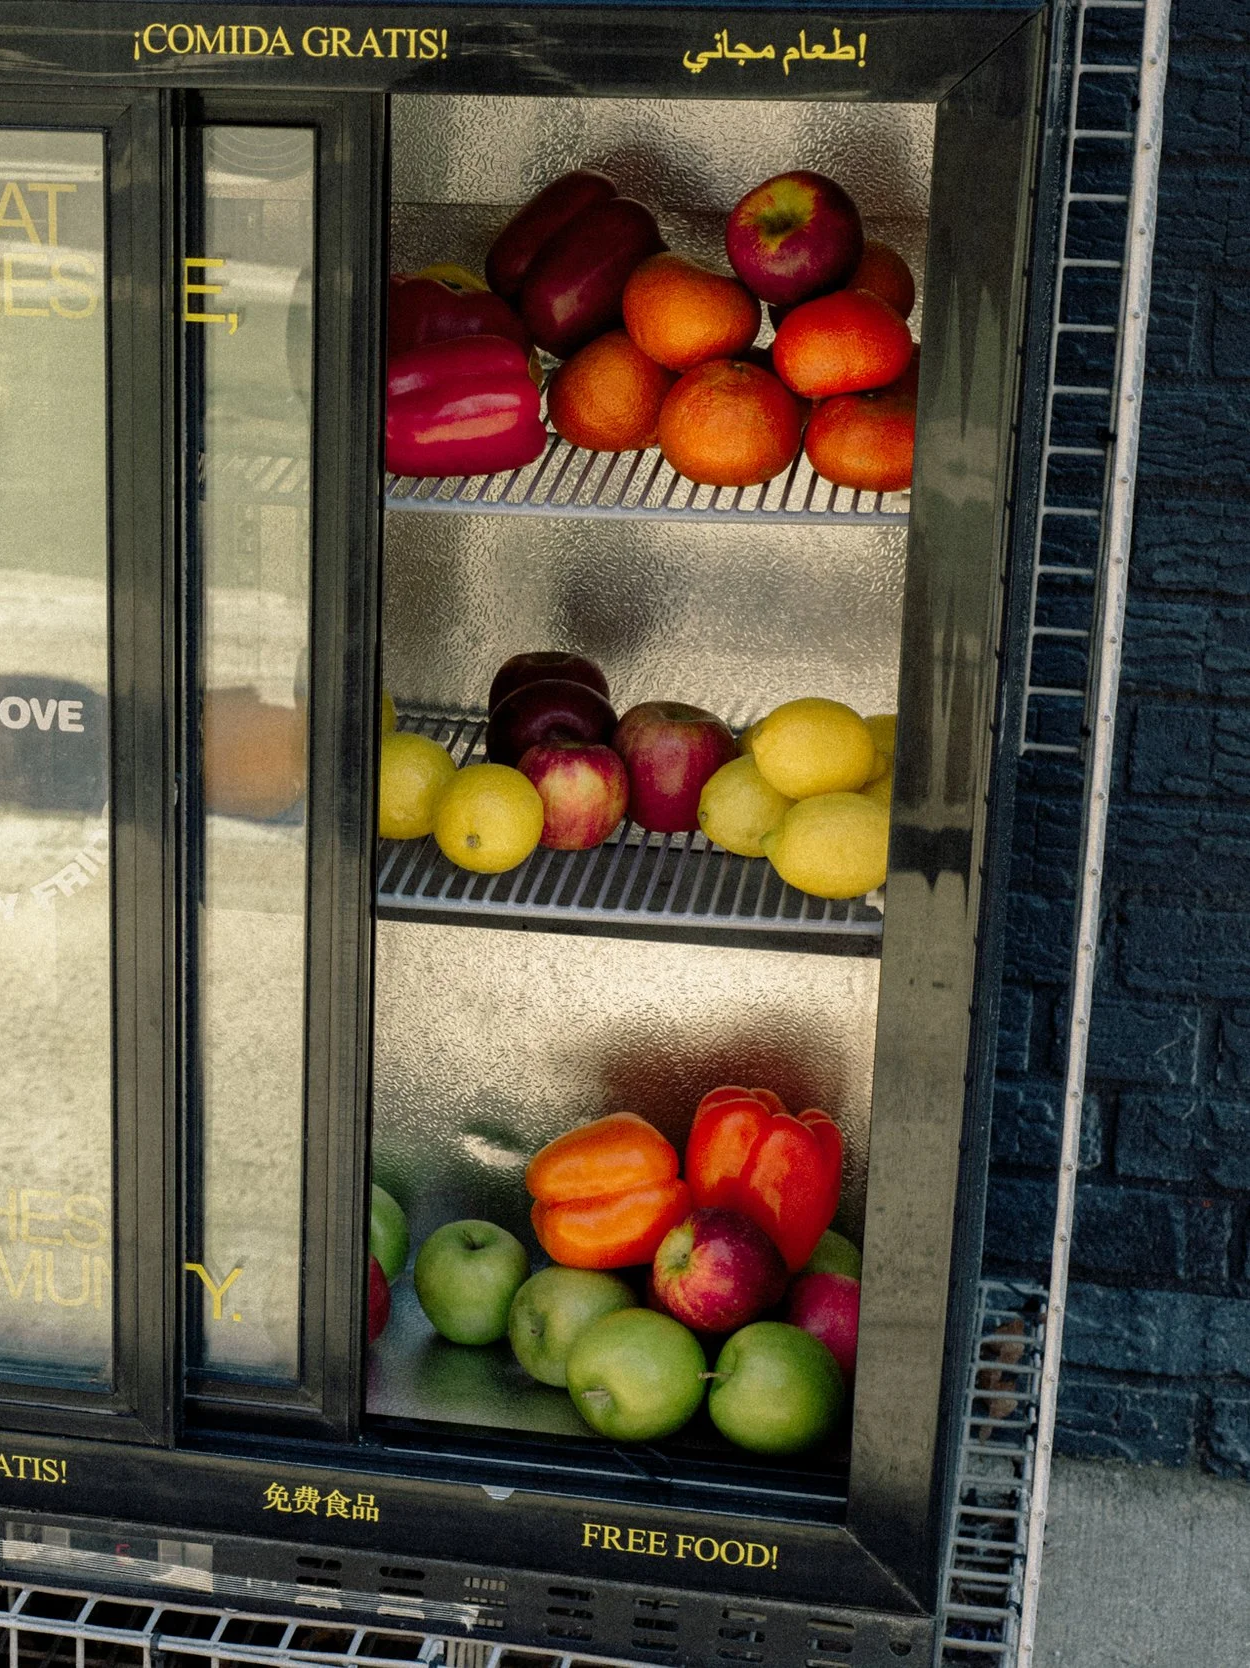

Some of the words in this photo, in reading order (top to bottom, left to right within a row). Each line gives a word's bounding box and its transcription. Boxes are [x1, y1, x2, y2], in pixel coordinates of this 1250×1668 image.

[133, 23, 294, 60] ¡COMIDA
[301, 26, 448, 60] GRATIS!
[682, 28, 776, 74] مجاني
[262, 1481, 380, 1522] 免费食品
[582, 1522, 667, 1556] FREE
[675, 1534, 779, 1570] FOOD!
